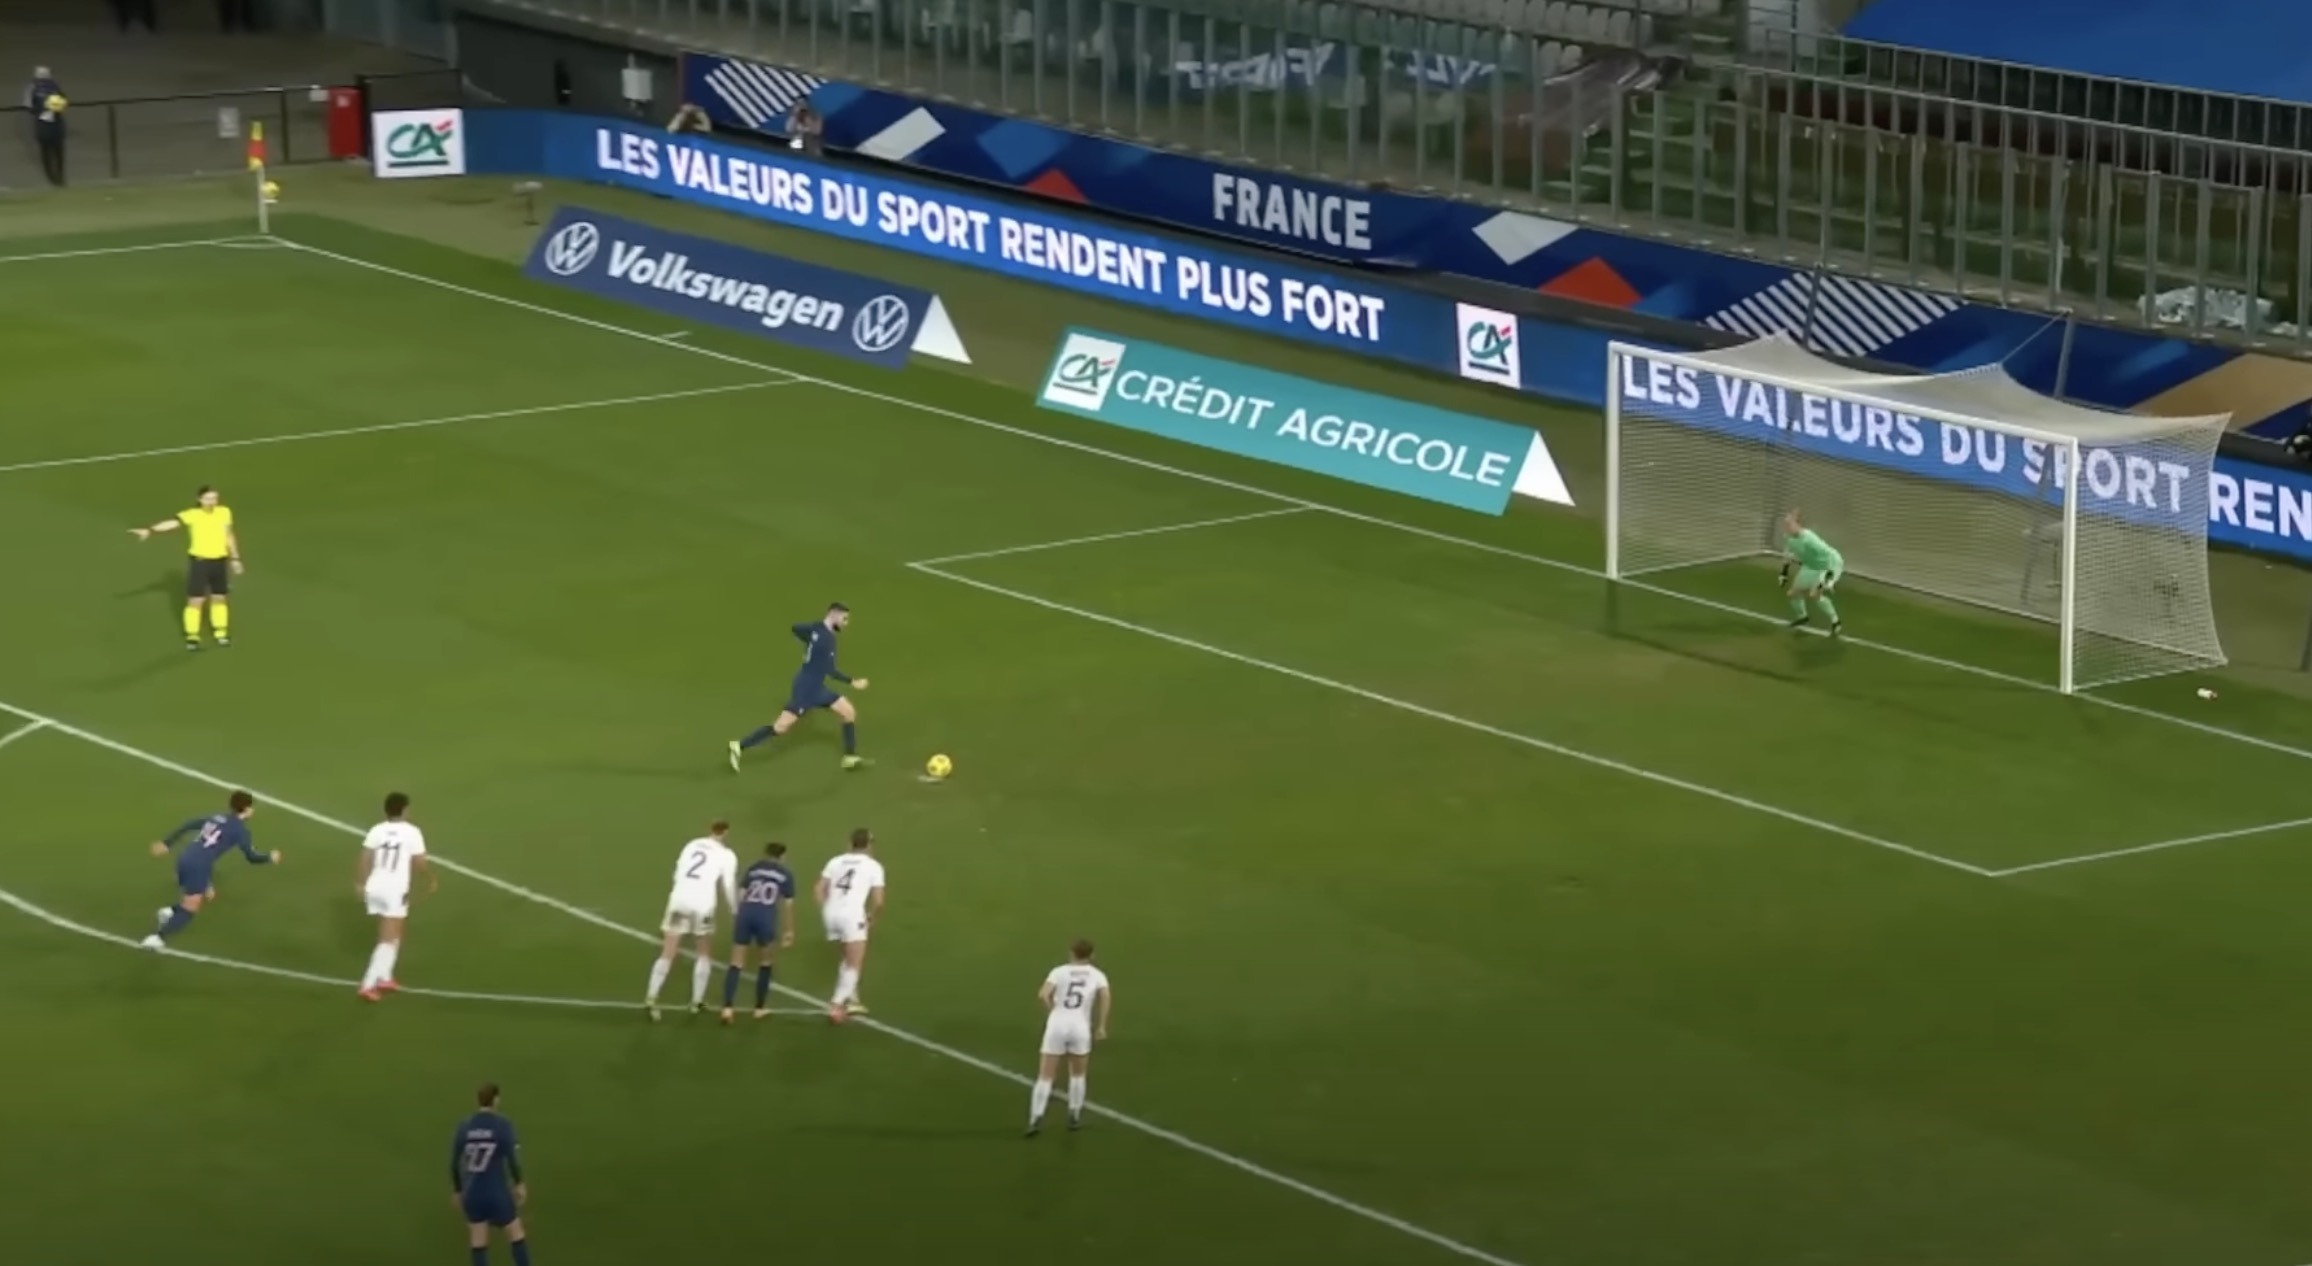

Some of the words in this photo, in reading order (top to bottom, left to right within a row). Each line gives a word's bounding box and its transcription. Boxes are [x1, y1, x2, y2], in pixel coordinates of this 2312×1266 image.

[596, 128, 660, 180] LES
[666, 143, 814, 215] VALEURS
[820, 178, 869, 227] DU
[877, 190, 991, 254] SPORT
[999, 216, 1168, 294] RENDENT
[1176, 255, 1272, 318] PLUS
[1281, 278, 1385, 342] FORT
[1213, 172, 1372, 251] FRANCE
[606, 239, 845, 330] Volkswagen
[1116, 369, 1276, 430] CRÉDIT
[1275, 407, 1511, 487] AGRICOLE
[1622, 354, 1701, 410] LES
[1715, 374, 1925, 456] VALEURS
[1940, 421, 2006, 474] DU
[2022, 439, 2190, 514] SPORT
[686, 850, 707, 880] 2
[746, 880, 779, 905] 20
[835, 868, 856, 896] 4
[1063, 980, 1086, 1010] 5
